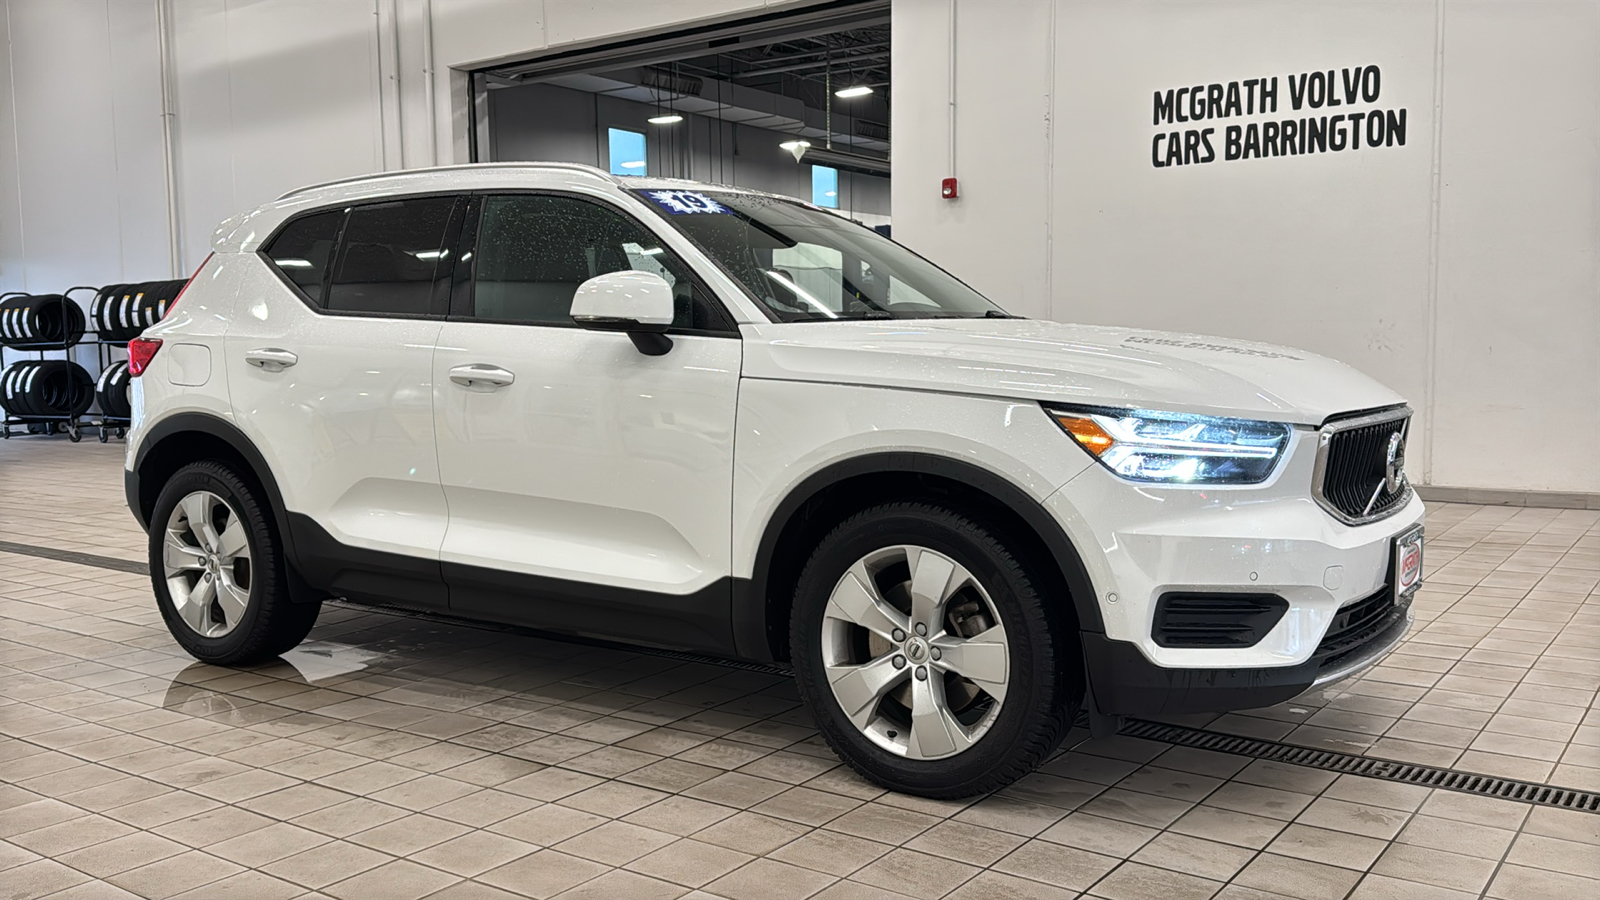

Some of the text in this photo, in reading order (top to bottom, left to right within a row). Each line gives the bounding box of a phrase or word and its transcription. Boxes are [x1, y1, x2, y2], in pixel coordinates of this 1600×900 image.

[1153, 65, 1381, 126] MCGRATH VOLVO
[1152, 109, 1407, 168] CARS BARRINGTON
[671, 194, 709, 209] 19
